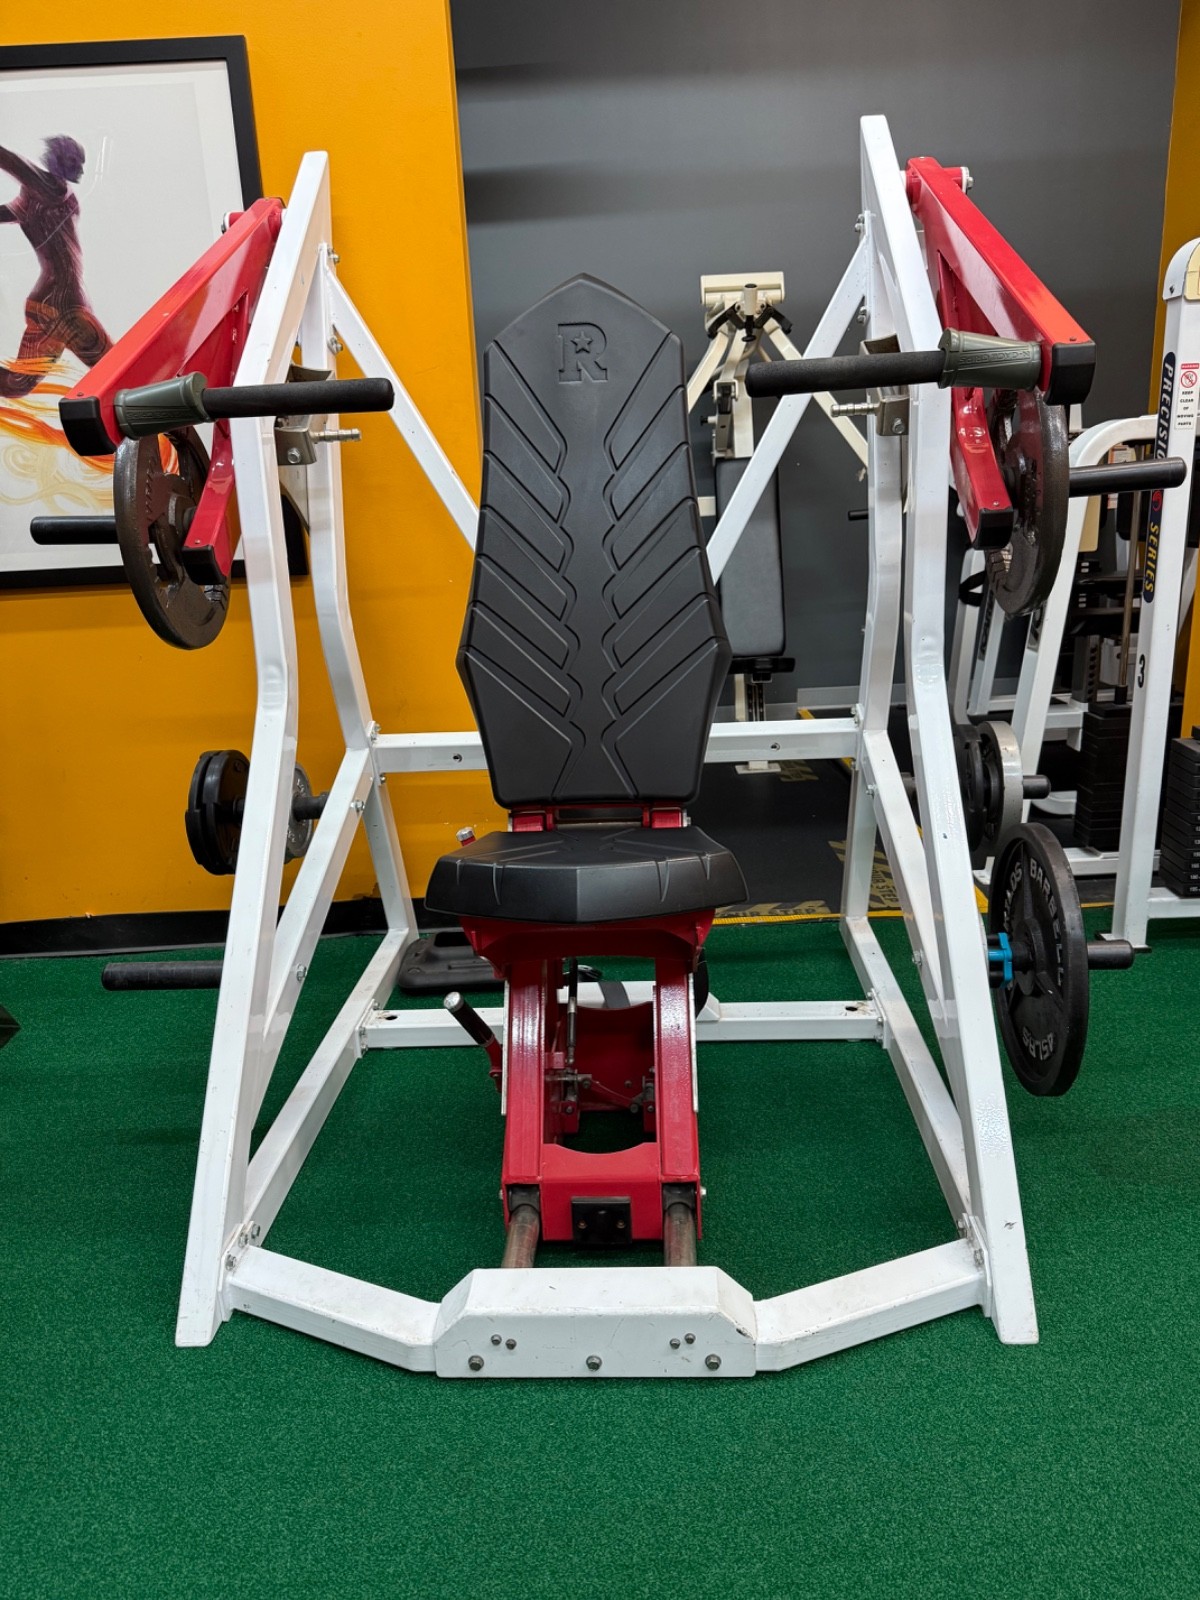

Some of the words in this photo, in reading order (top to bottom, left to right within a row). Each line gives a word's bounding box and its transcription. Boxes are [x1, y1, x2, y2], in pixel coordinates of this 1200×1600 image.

[553, 317, 593, 367] R
[1157, 363, 1173, 459] PRECISIO
[1144, 521, 1159, 593] SERIES
[1137, 653, 1146, 688] 3
[1030, 857, 1064, 986] BARBELL
